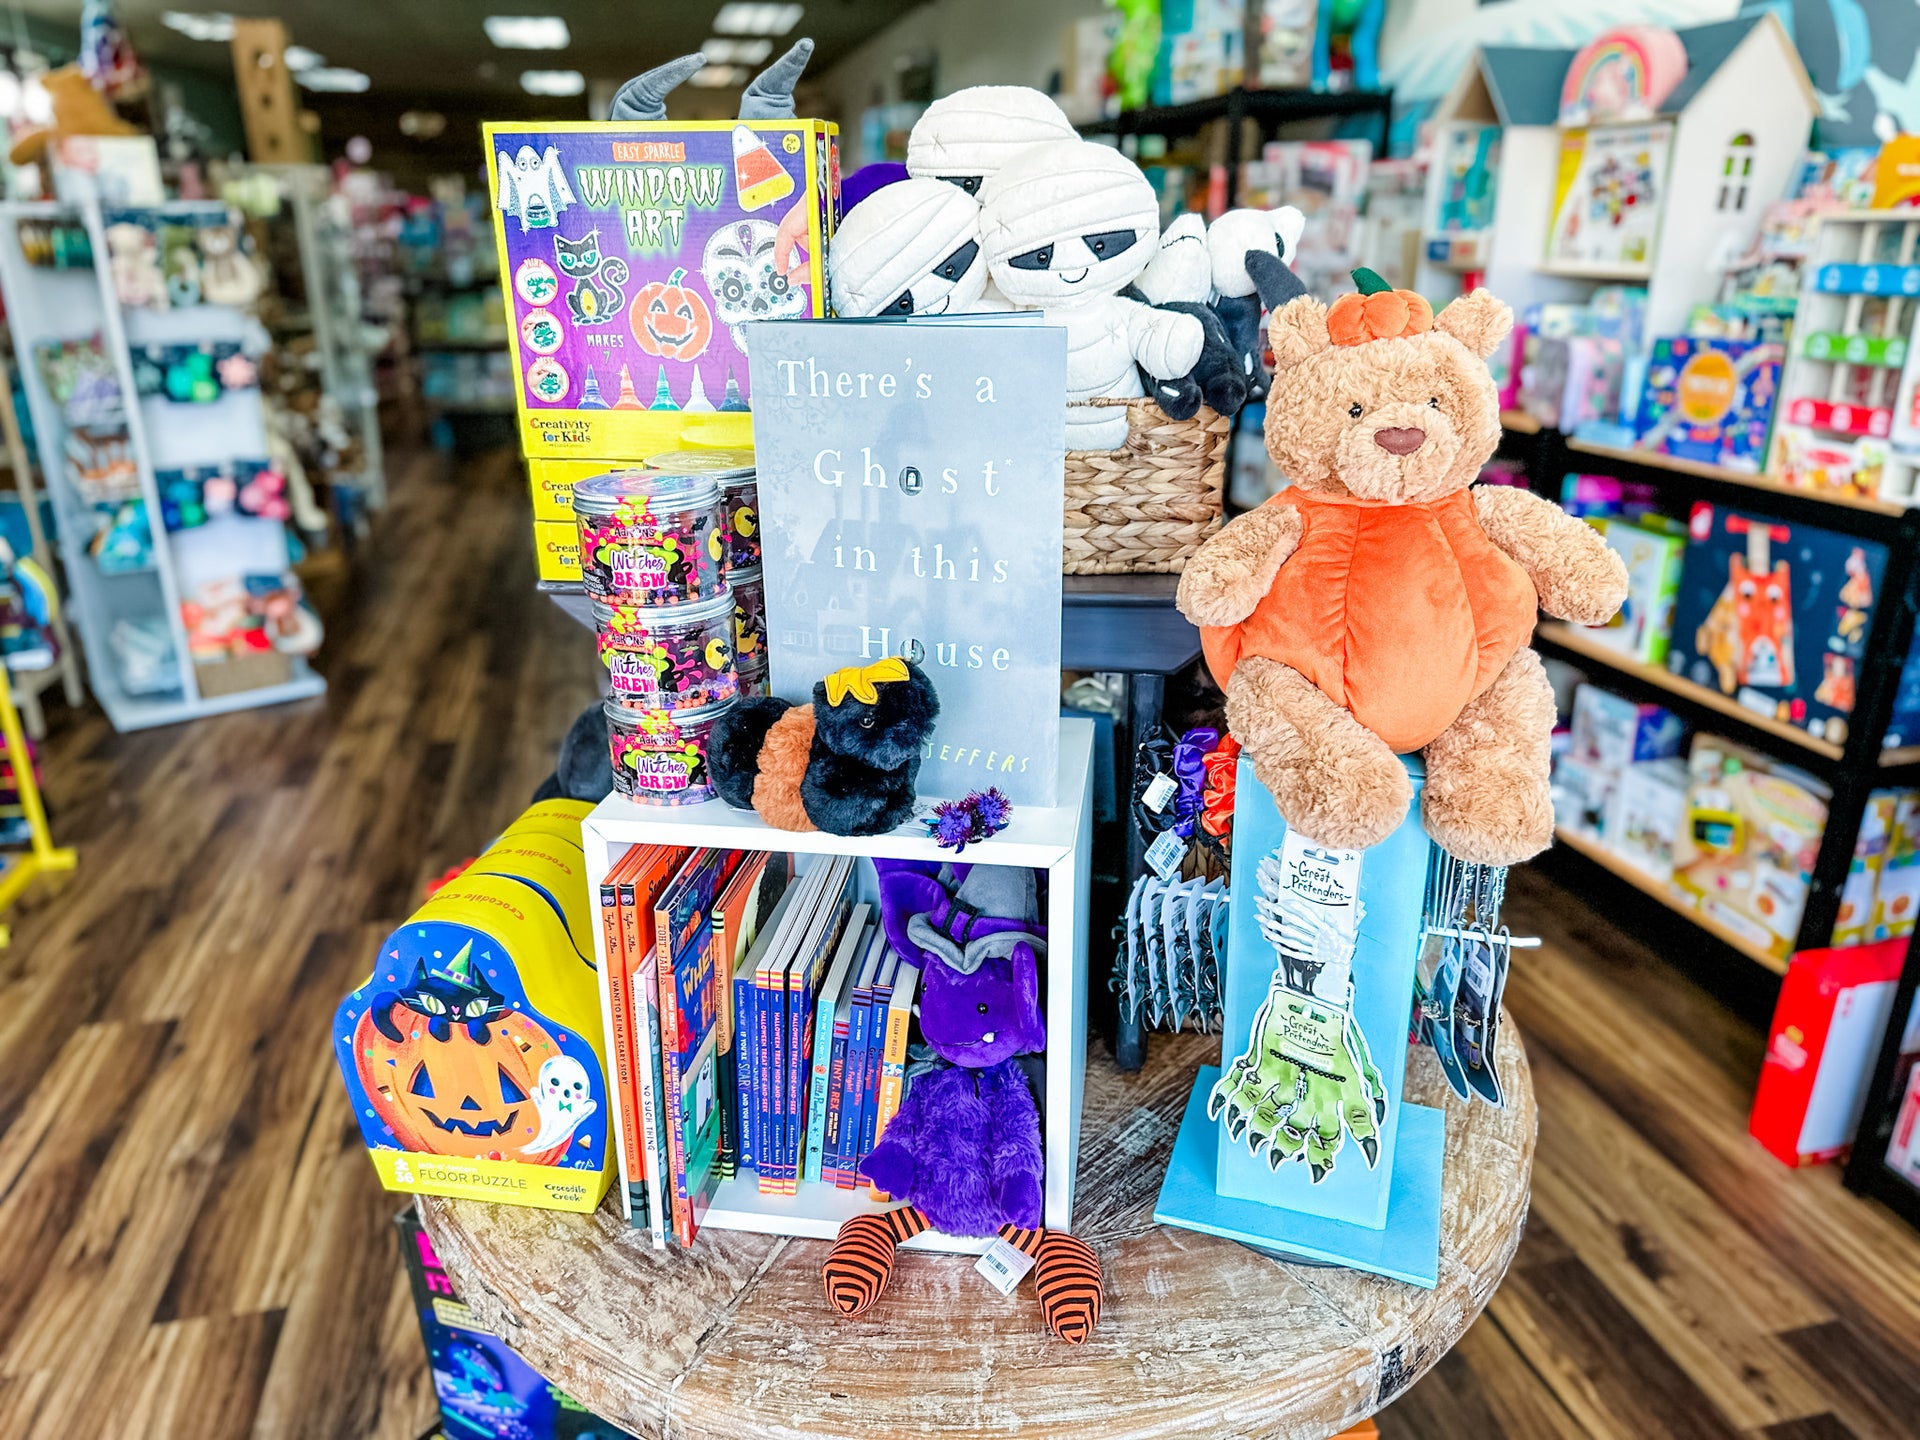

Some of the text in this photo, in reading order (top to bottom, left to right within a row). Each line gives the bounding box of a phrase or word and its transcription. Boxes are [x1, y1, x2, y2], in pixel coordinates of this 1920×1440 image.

[617, 143, 681, 160] EASY SPARKLE
[577, 166, 723, 206] WINDOW
[625, 209, 685, 247] ART
[586, 334, 625, 348] MAKES
[603, 350, 611, 365] 7
[777, 357, 997, 403] There's a
[530, 417, 592, 433] Creativity
[542, 430, 592, 443] for Kids
[541, 480, 574, 493] Creat
[554, 492, 572, 504] for
[547, 542, 580, 554] Creat
[559, 554, 576, 565] for
[611, 549, 665, 571] Witches
[834, 534, 1009, 584] in this
[614, 572, 667, 588] BREW
[858, 626, 1011, 670] House
[610, 654, 655, 676] Witches
[612, 675, 656, 693] BREW
[637, 753, 686, 773] Witches
[926, 743, 1030, 773] JEFFERS
[639, 775, 688, 789] BREW
[515, 849, 572, 876] Crocodile
[1344, 853, 1354, 861] 3+
[1298, 860, 1330, 883] Great
[1292, 874, 1344, 901] Pretenders
[464, 893, 525, 921] Crocodile
[606, 912, 615, 935] Taylor
[624, 911, 634, 935] Taylor
[658, 924, 667, 948] TOHT
[715, 969, 723, 982] The
[612, 980, 620, 1001] WANT
[636, 989, 644, 1003] Ella
[614, 1003, 621, 1012] TO
[637, 1006, 646, 1028] Bailey
[715, 983, 725, 1031] Pomegranate
[616, 1014, 622, 1022] BE
[617, 1024, 623, 1032] IN
[1289, 1015, 1317, 1036] Great
[1283, 1025, 1330, 1052] Pretenders
[618, 1041, 626, 1062] SCARY
[672, 1066, 680, 1094] WHEELS
[738, 1063, 751, 1092] SCARY
[833, 1058, 843, 1081] TINY
[813, 1076, 825, 1096] Little
[832, 1082, 841, 1090] T.
[673, 1096, 679, 1105] ON
[830, 1091, 840, 1110] REX
[883, 1082, 895, 1123] How to Scare
[624, 1104, 633, 1142] CANDLEWICK
[643, 1085, 655, 1151] NO SUCH THING
[676, 1141, 684, 1174] HALLOWEEN
[419, 1169, 468, 1183] FLOOR
[472, 1174, 527, 1190] PUZZLE
[544, 1183, 587, 1194] Crocodile
[552, 1192, 582, 1202] Creek
